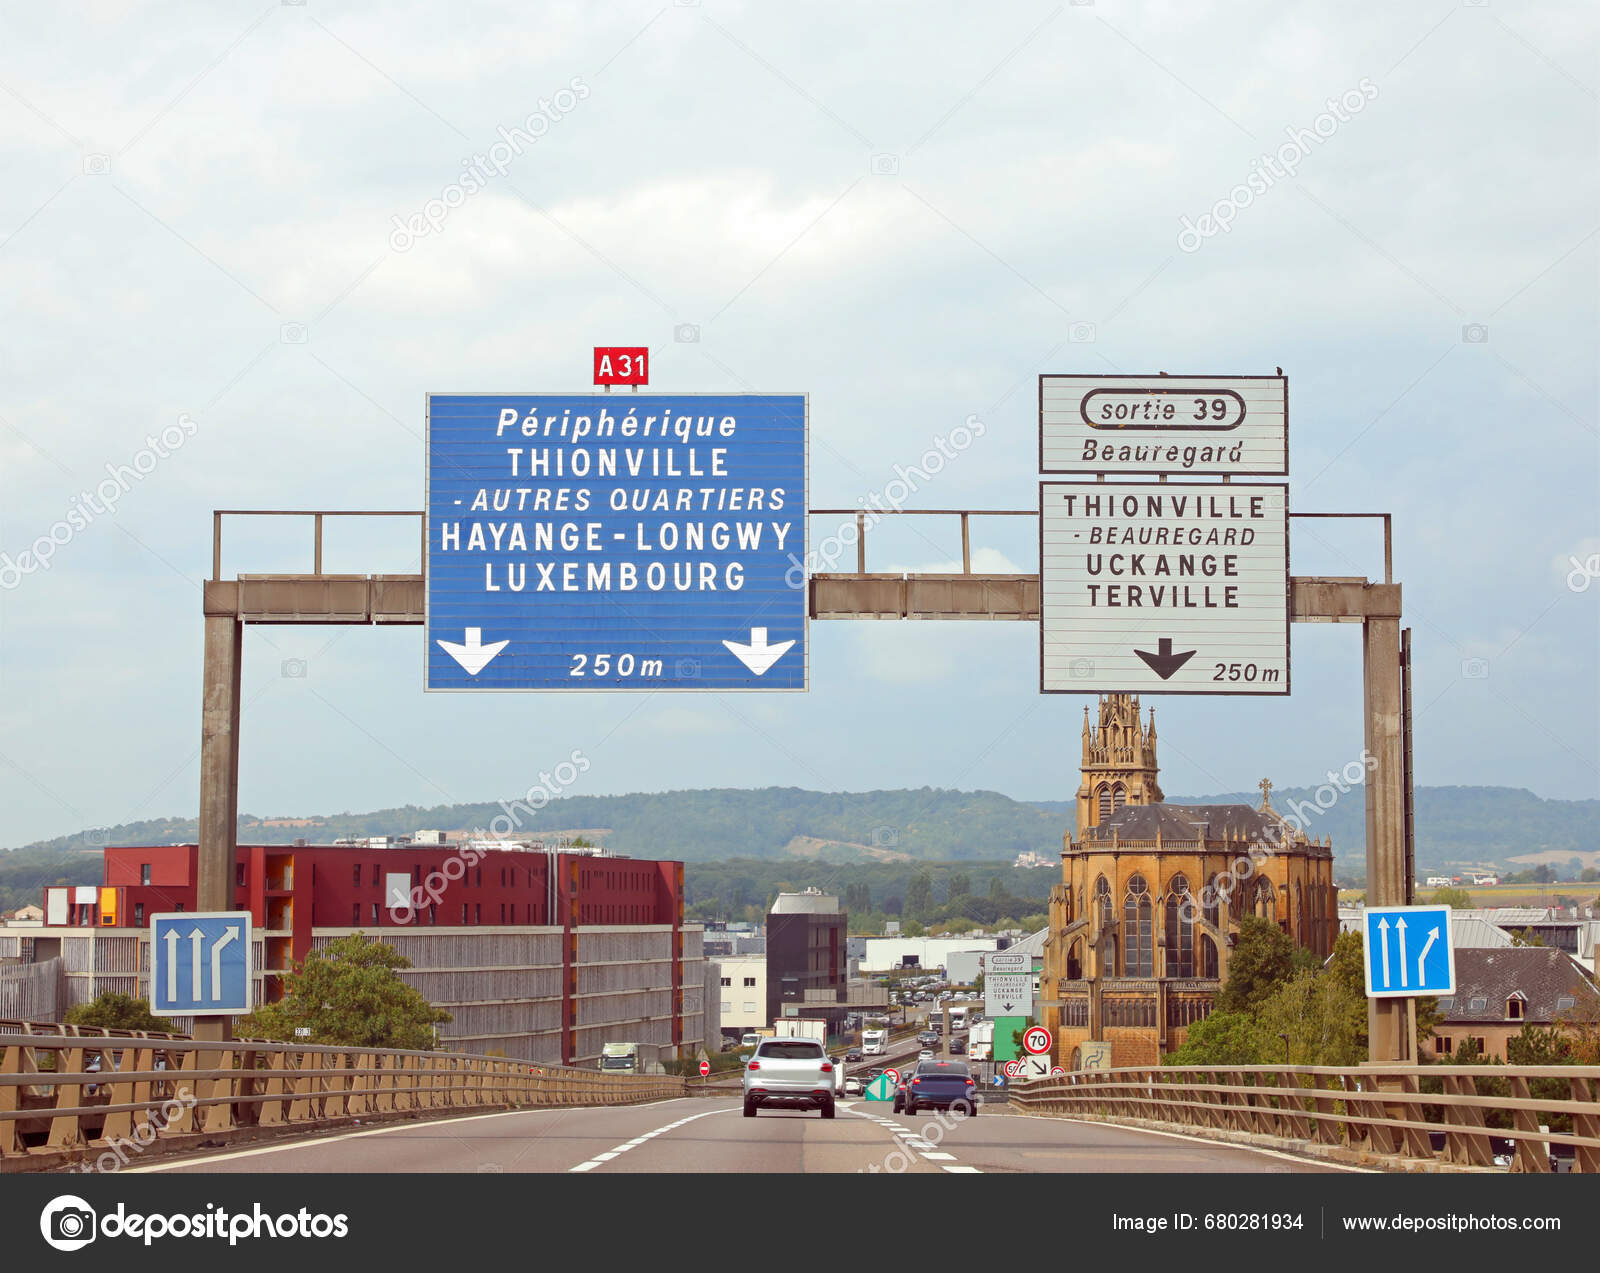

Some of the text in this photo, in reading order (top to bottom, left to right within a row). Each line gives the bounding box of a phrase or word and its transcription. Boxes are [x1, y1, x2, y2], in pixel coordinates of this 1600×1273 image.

[1101, 398, 1227, 421] sortie 39
[496, 407, 736, 444] Périphérique
[507, 447, 728, 477] THIONVILLE
[1081, 438, 1243, 469] Beauregard
[471, 488, 591, 511] AUTRES
[609, 487, 785, 511] QUARTIERS
[1063, 495, 1265, 519] THIONVILLE
[1089, 526, 1255, 546] BEAUREGARD
[485, 561, 745, 592] LUXEMBOURG
[1086, 553, 1239, 577] UCKANGE
[1086, 584, 1239, 609] TERVILLE
[569, 653, 663, 677] 250m
[1030, 1035, 1046, 1047] 70
